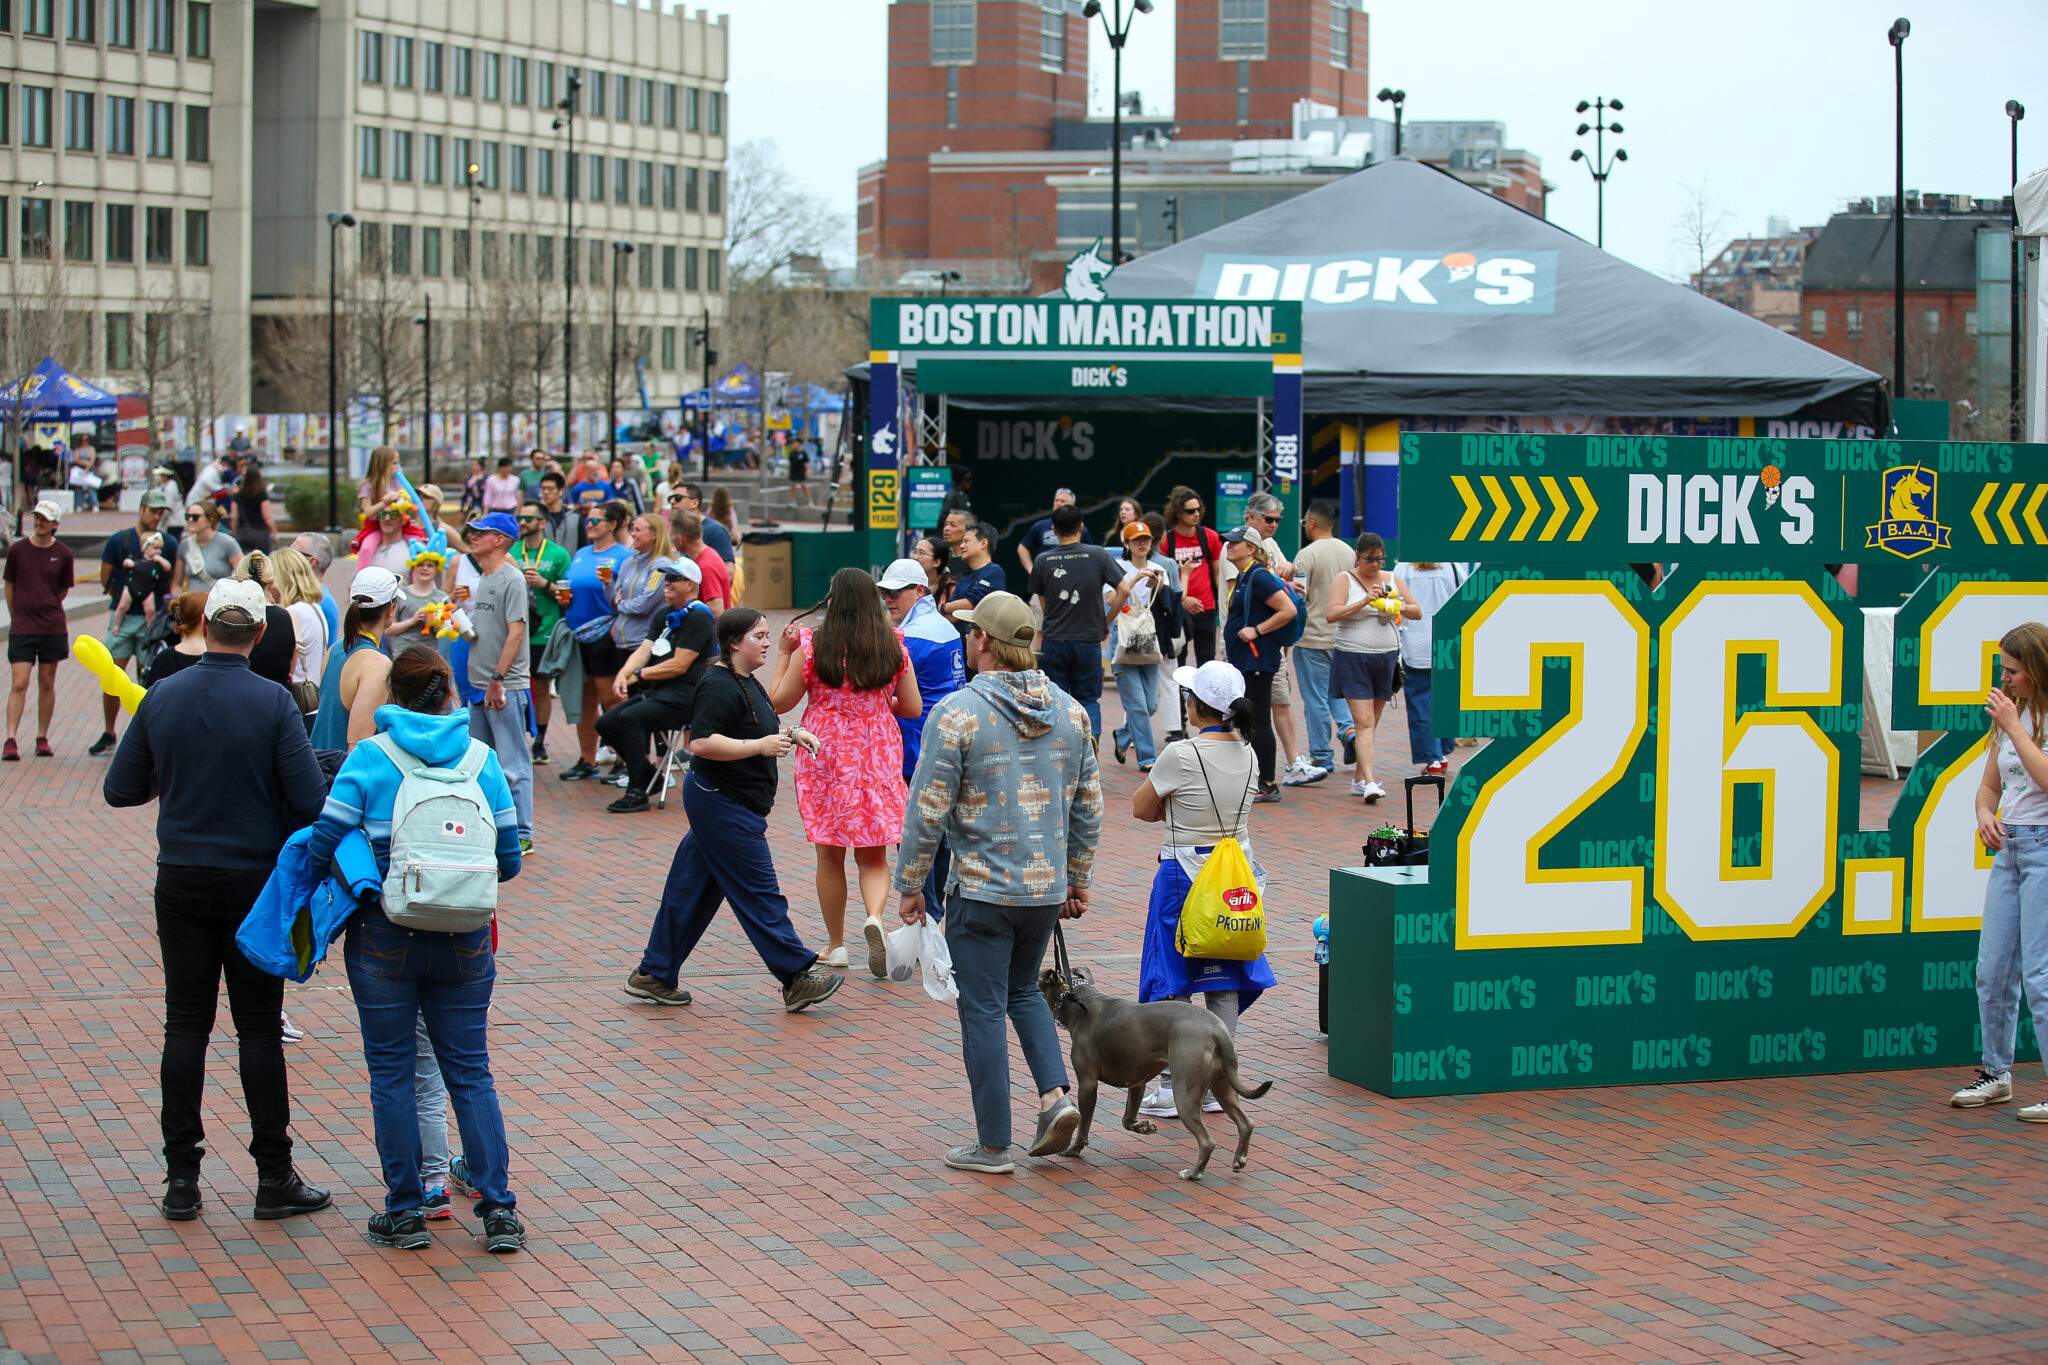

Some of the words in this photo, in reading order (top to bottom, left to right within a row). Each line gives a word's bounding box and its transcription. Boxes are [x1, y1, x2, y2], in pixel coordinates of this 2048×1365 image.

[1213, 252, 1536, 305] DICK'S
[900, 304, 1048, 345] BOSTON
[1059, 305, 1273, 347] MARATHON
[1072, 365, 1128, 387] DICK'S
[977, 416, 1095, 460] DICK'S
[1461, 434, 1546, 467] DICK'S
[1586, 435, 1668, 468] DICK'S
[1707, 438, 1786, 469] DICK'S
[1825, 440, 1902, 471] DICK'S
[1275, 434, 1298, 481] 1897
[1938, 443, 2014, 474] DICK'S
[872, 475, 895, 513] 129
[1627, 465, 1816, 545] DICK'S
[872, 514, 896, 523] YEARS
[1887, 523, 1933, 537] B.A.A.
[1932, 704, 1986, 731] DICK
[1394, 908, 1456, 945] DICK
[1453, 975, 1537, 1012] DICK'S
[1576, 970, 1657, 1007] DICK'S
[1695, 965, 1774, 1001] DICK'S
[1810, 960, 1887, 996] DICK'S
[1512, 1039, 1593, 1077] DICK'S
[1632, 1033, 1712, 1070] DICK'S
[1750, 1028, 1827, 1064] DICK'S
[1863, 1022, 1938, 1058] DICK'S
[1392, 1045, 1472, 1083] DICK'S
